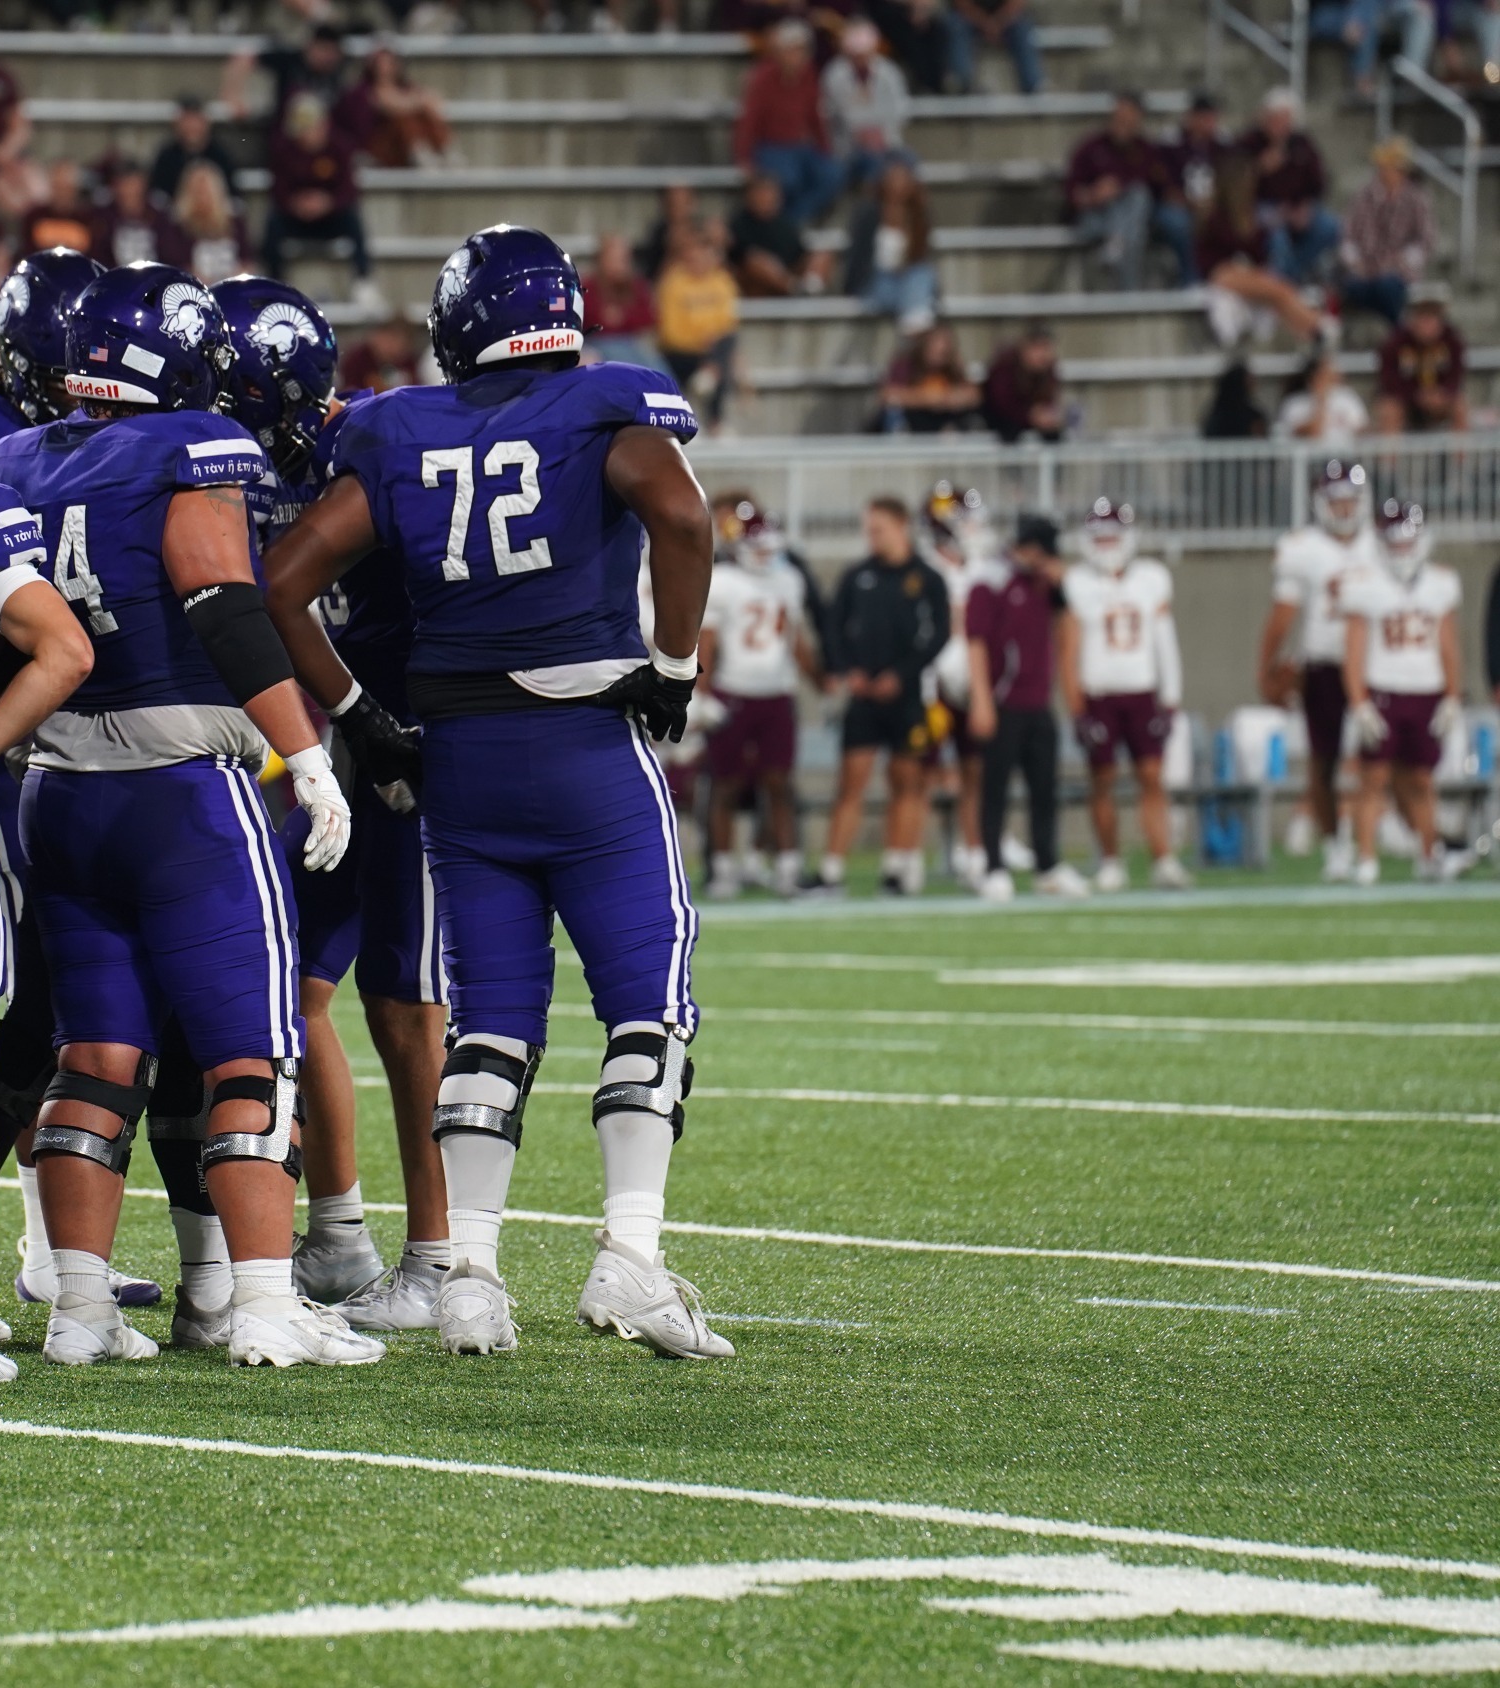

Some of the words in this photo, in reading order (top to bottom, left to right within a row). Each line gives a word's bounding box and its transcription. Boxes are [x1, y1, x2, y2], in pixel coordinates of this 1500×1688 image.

[509, 333, 575, 356] Riddell
[66, 379, 120, 399] Riddell
[421, 435, 553, 582] 72
[33, 504, 120, 636] 4
[203, 1141, 229, 1156] ONJOY
